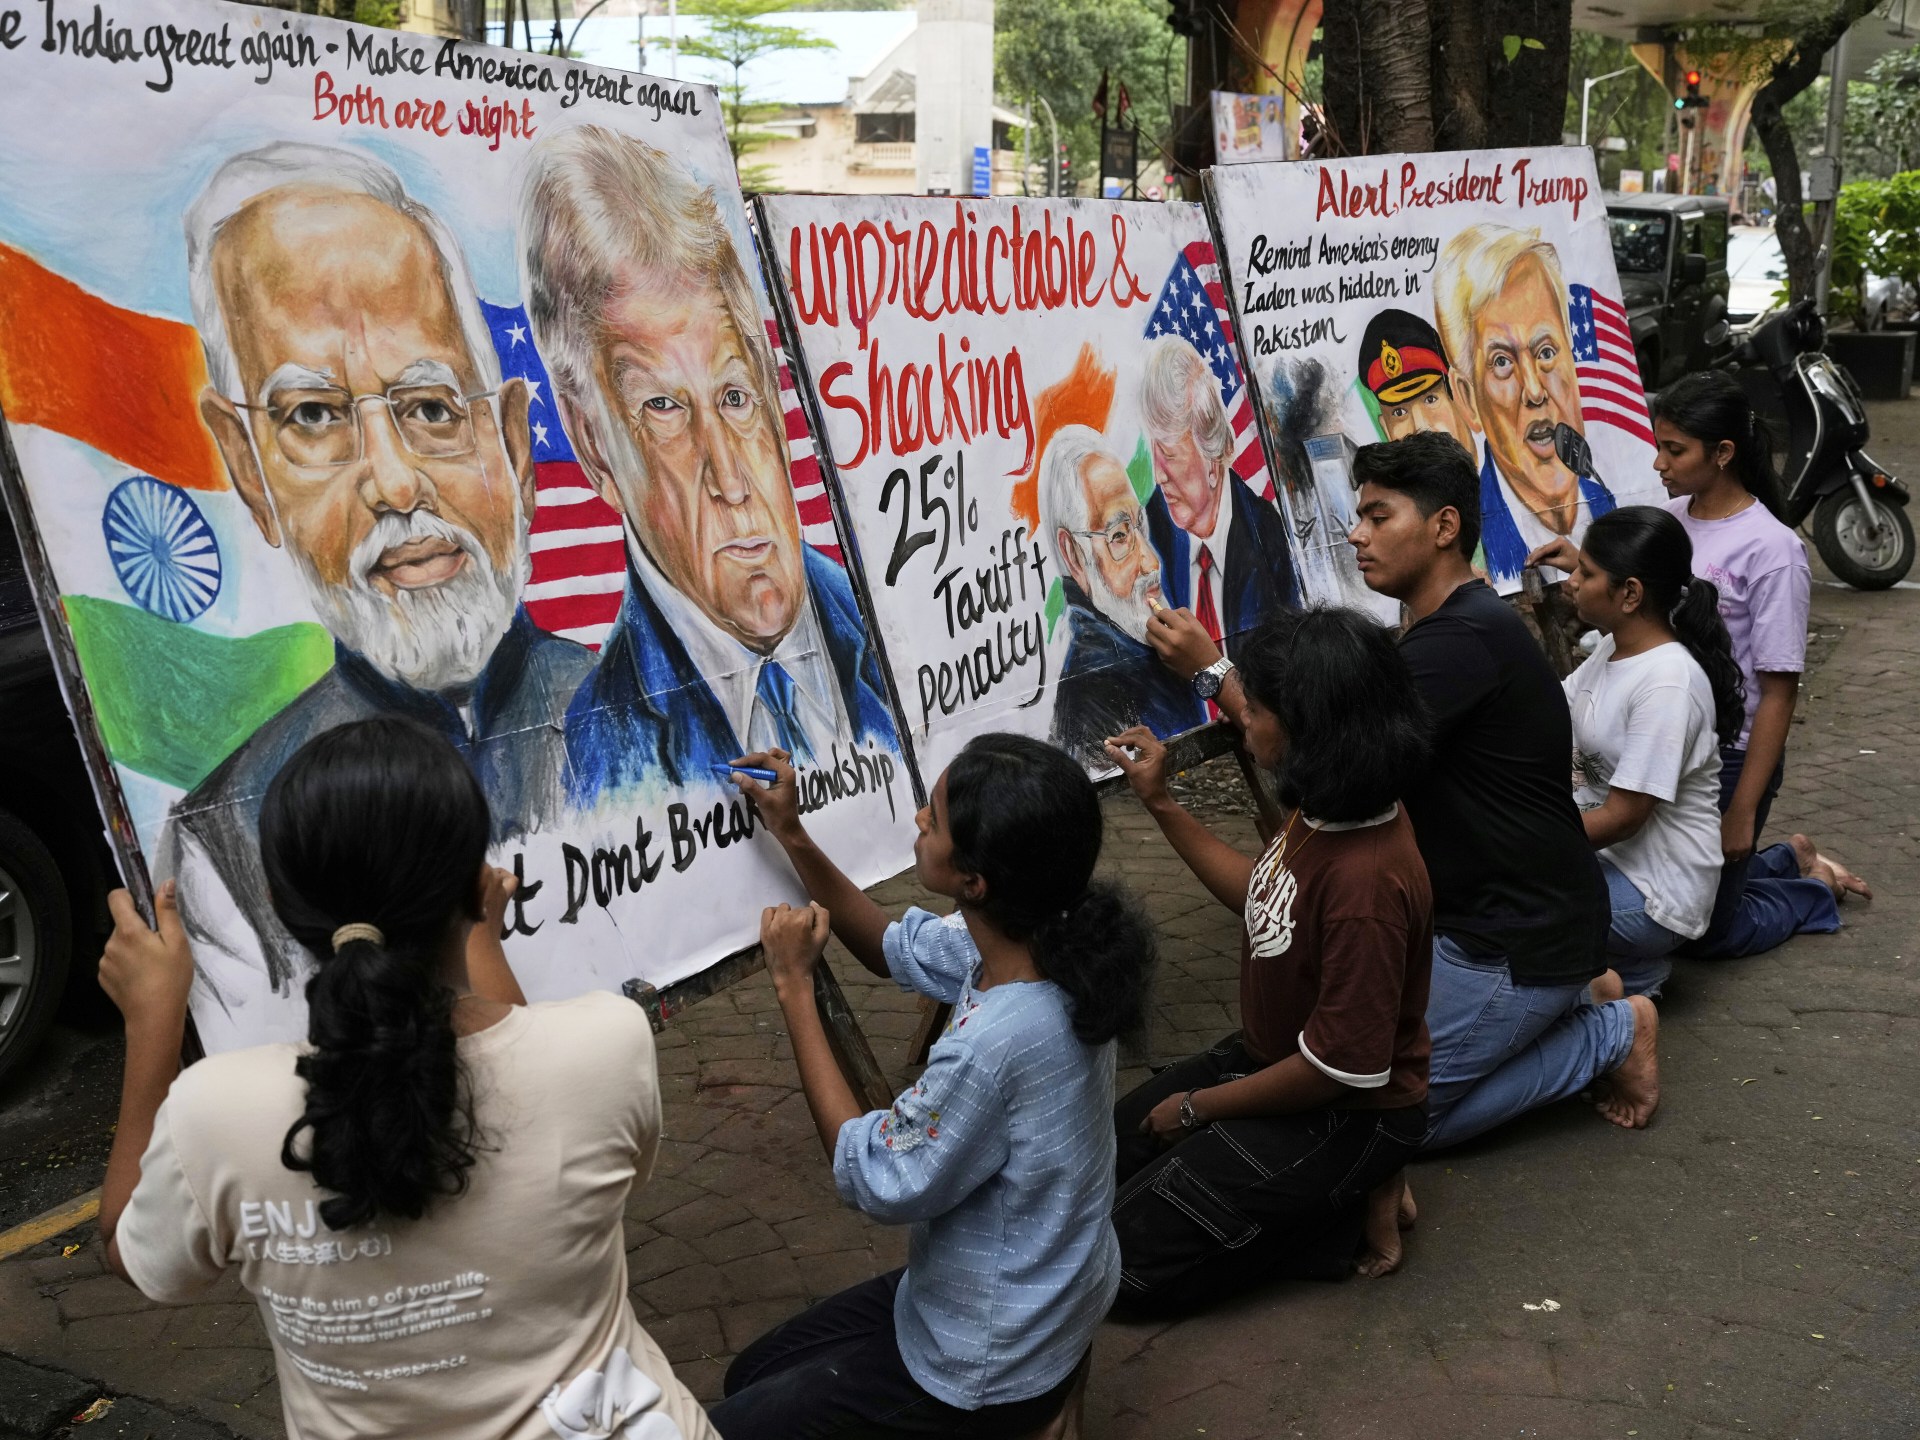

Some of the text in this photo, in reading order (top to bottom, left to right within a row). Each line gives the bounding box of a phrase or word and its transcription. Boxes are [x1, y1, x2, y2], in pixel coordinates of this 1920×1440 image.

[38, 0, 144, 63] India
[144, 23, 236, 93] great
[241, 21, 321, 85] again
[347, 28, 431, 75] Make
[435, 38, 560, 92] America
[559, 67, 634, 109] great
[637, 82, 702, 122] again
[313, 70, 538, 152] Both are right
[1400, 158, 1507, 209] President
[1511, 158, 1588, 222] Trump
[1111, 214, 1152, 308] &
[1247, 232, 1440, 279] Remind America's enemy
[1302, 281, 1335, 304] was
[1339, 270, 1400, 303] hidden
[1405, 268, 1421, 296] in
[1254, 316, 1347, 357] Pakistan
[878, 449, 979, 588] 25%
[917, 611, 1047, 738] penalty
[796, 739, 897, 824] iendship
[384, 1285, 404, 1305] of
[408, 1279, 452, 1303] your
